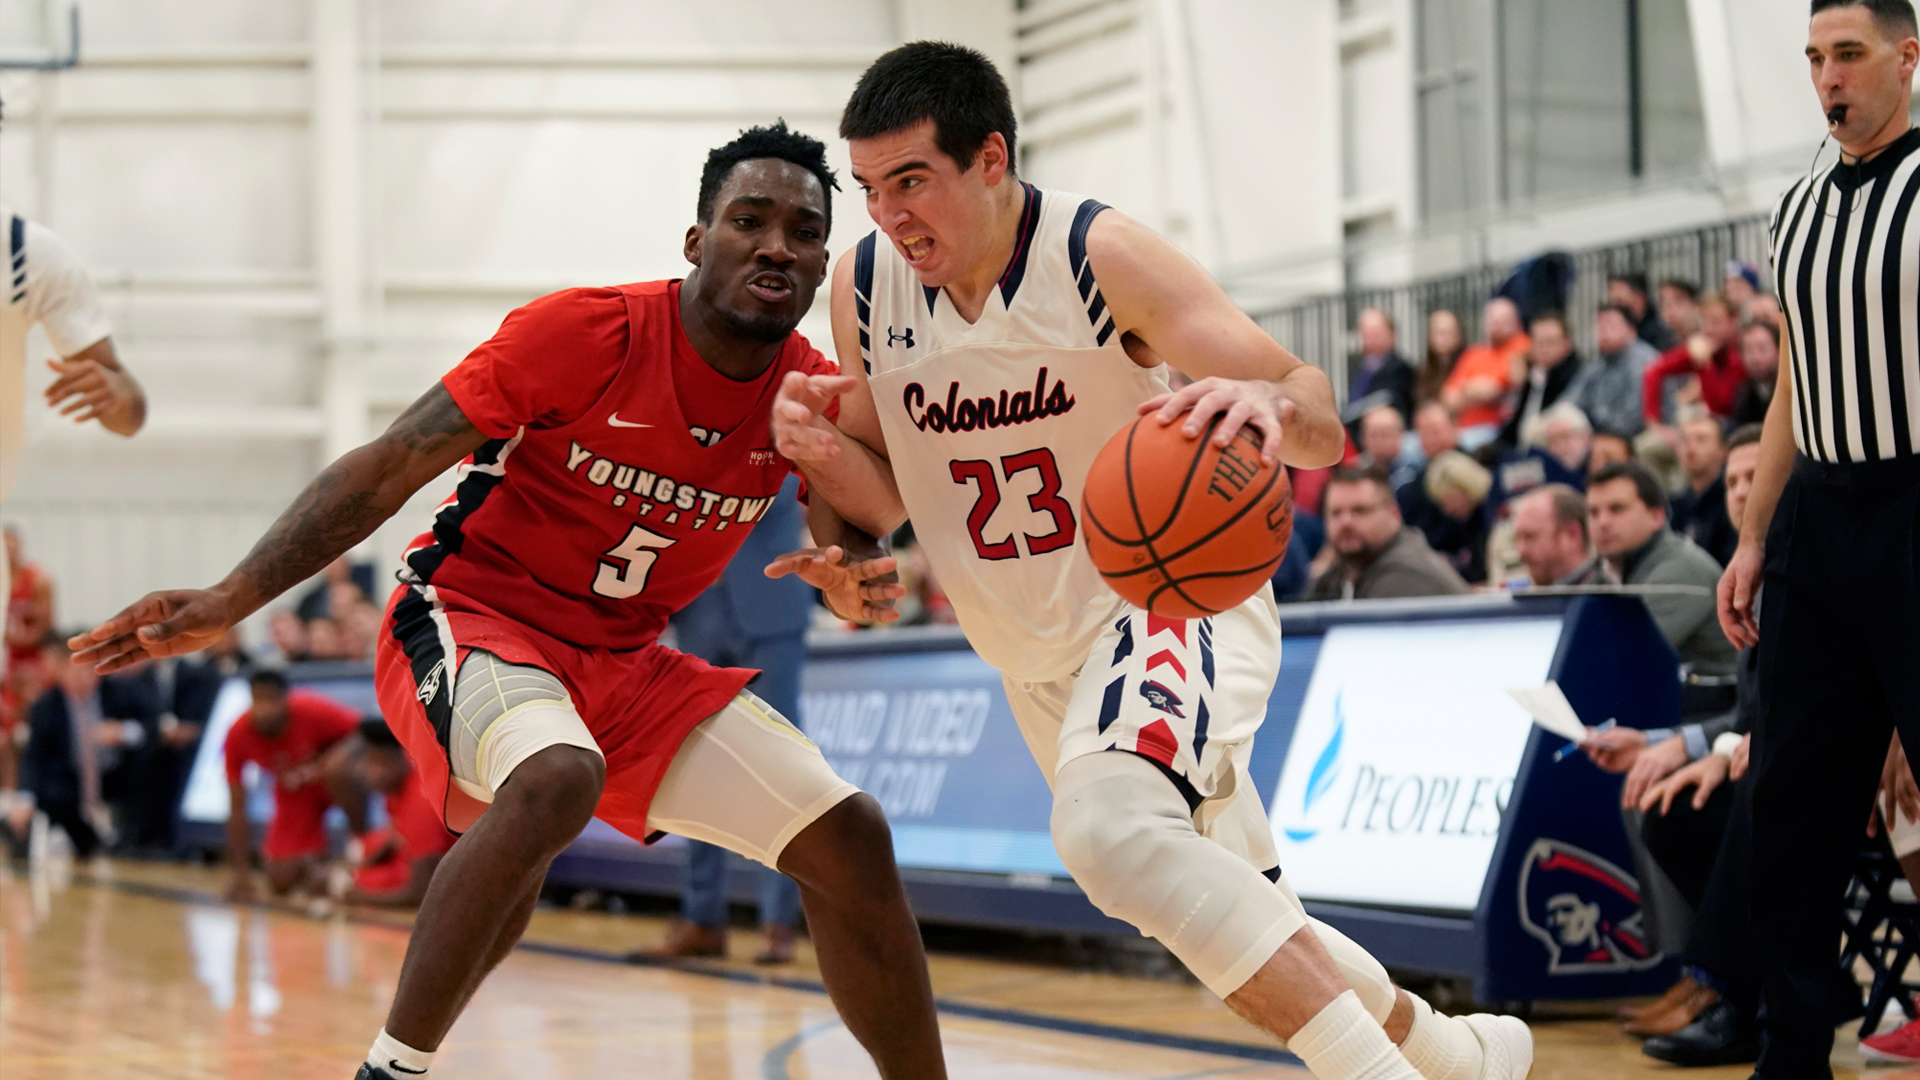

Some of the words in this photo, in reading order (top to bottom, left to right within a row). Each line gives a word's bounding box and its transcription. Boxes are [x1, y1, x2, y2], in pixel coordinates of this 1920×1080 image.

[903, 366, 1076, 433] Colonials
[949, 447, 1077, 561] 23
[1207, 444, 1260, 502] THE
[612, 495, 729, 531] STATE
[591, 522, 679, 599] 5
[883, 688, 991, 757] VIDEO
